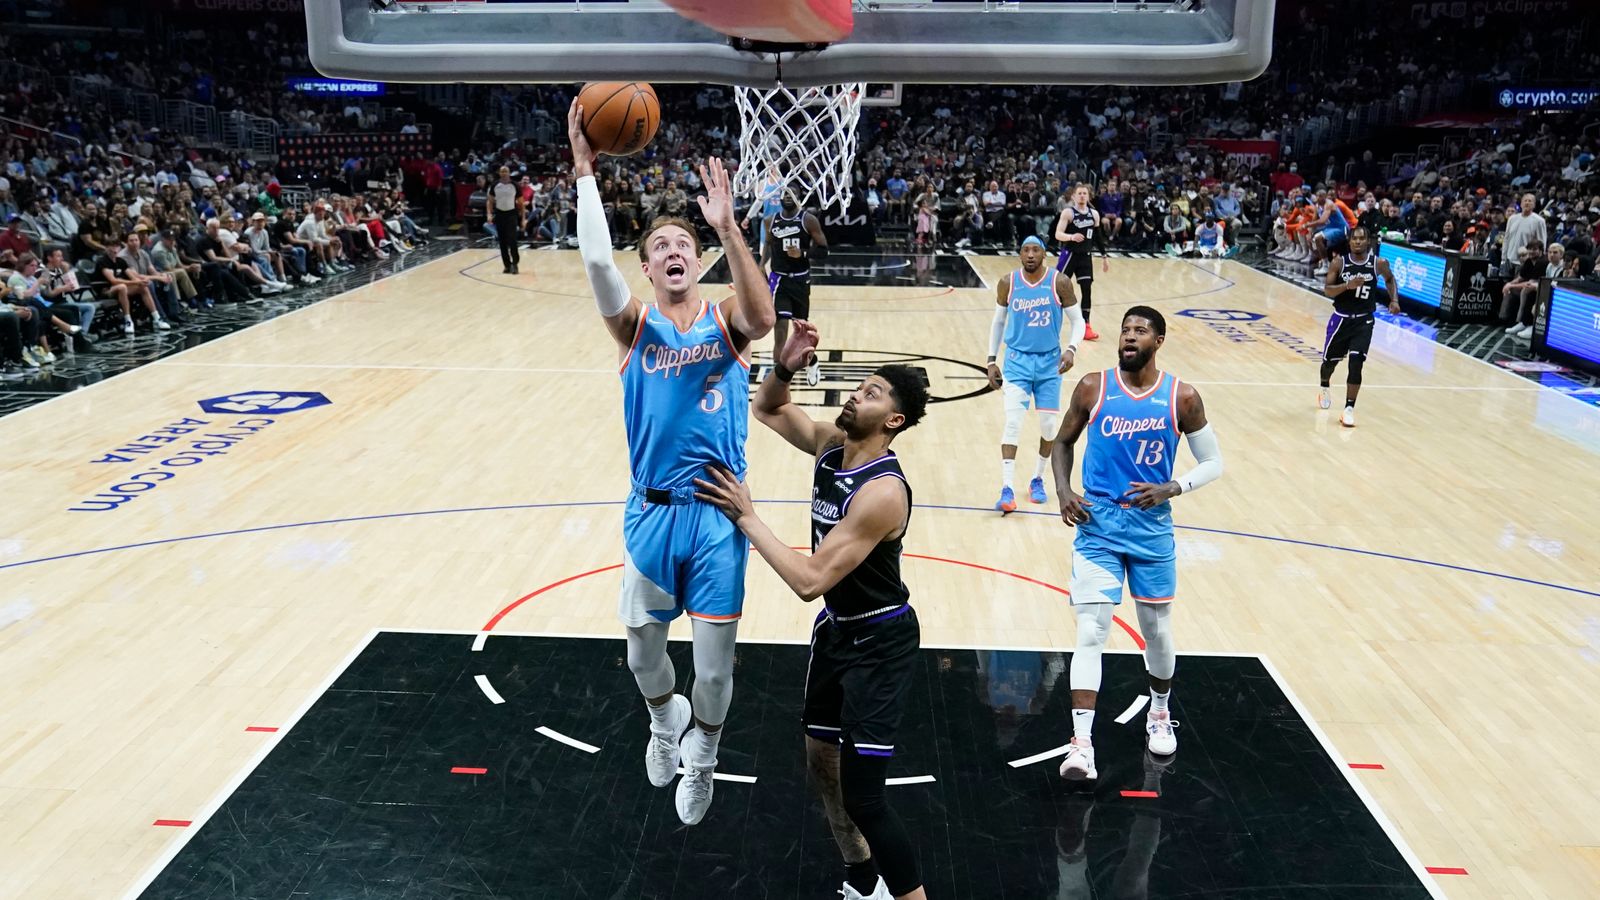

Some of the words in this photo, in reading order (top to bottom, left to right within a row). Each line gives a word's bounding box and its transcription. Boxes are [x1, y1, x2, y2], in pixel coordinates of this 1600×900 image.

[340, 83, 378, 92] EXPRESS
[1355, 285, 1371, 299] 15
[1459, 292, 1493, 303] AGUA
[1012, 296, 1051, 313] Clippers
[1457, 303, 1492, 311] CALIENTE
[1028, 311, 1051, 327] 23
[641, 341, 724, 379] Clippers
[700, 373, 723, 412] 5
[1101, 415, 1167, 441] Clippers
[89, 417, 211, 463] ARENA
[1135, 439, 1165, 466] 13
[67, 418, 276, 512] crypto.com
